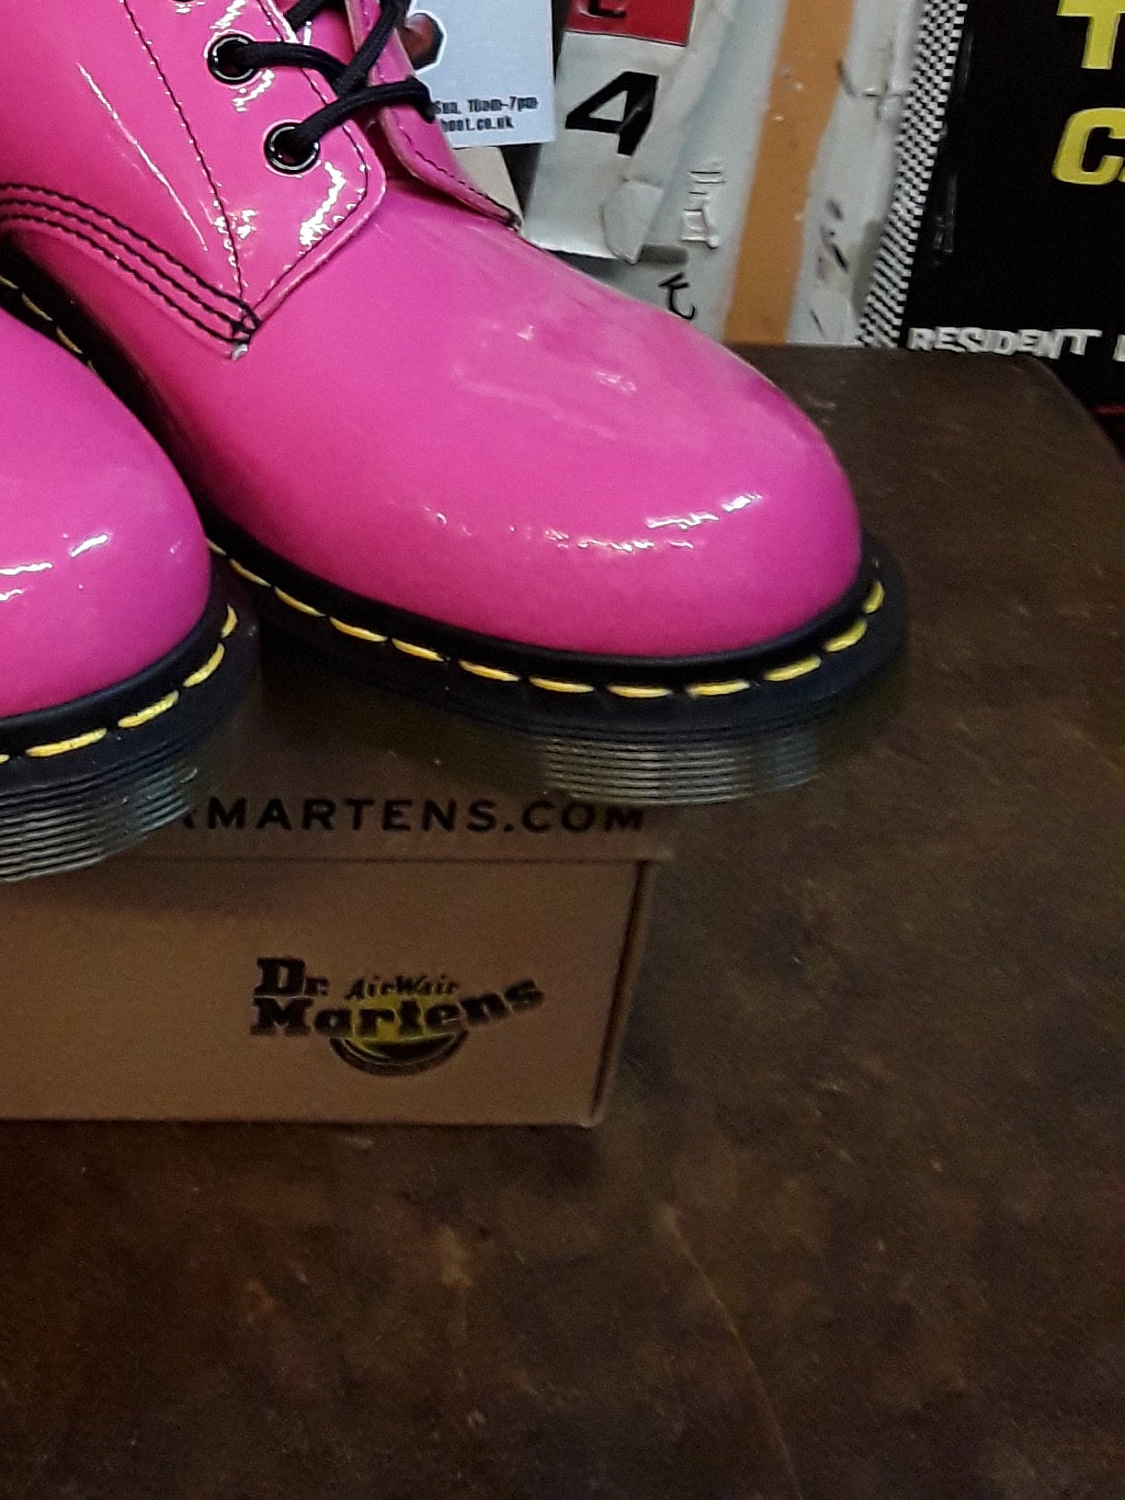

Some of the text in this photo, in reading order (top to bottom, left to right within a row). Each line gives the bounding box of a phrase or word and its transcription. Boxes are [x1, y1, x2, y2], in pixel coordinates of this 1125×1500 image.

[565, 71, 659, 156] 4
[906, 326, 1103, 360] RESIDENT
[249, 976, 546, 1038] Martens
